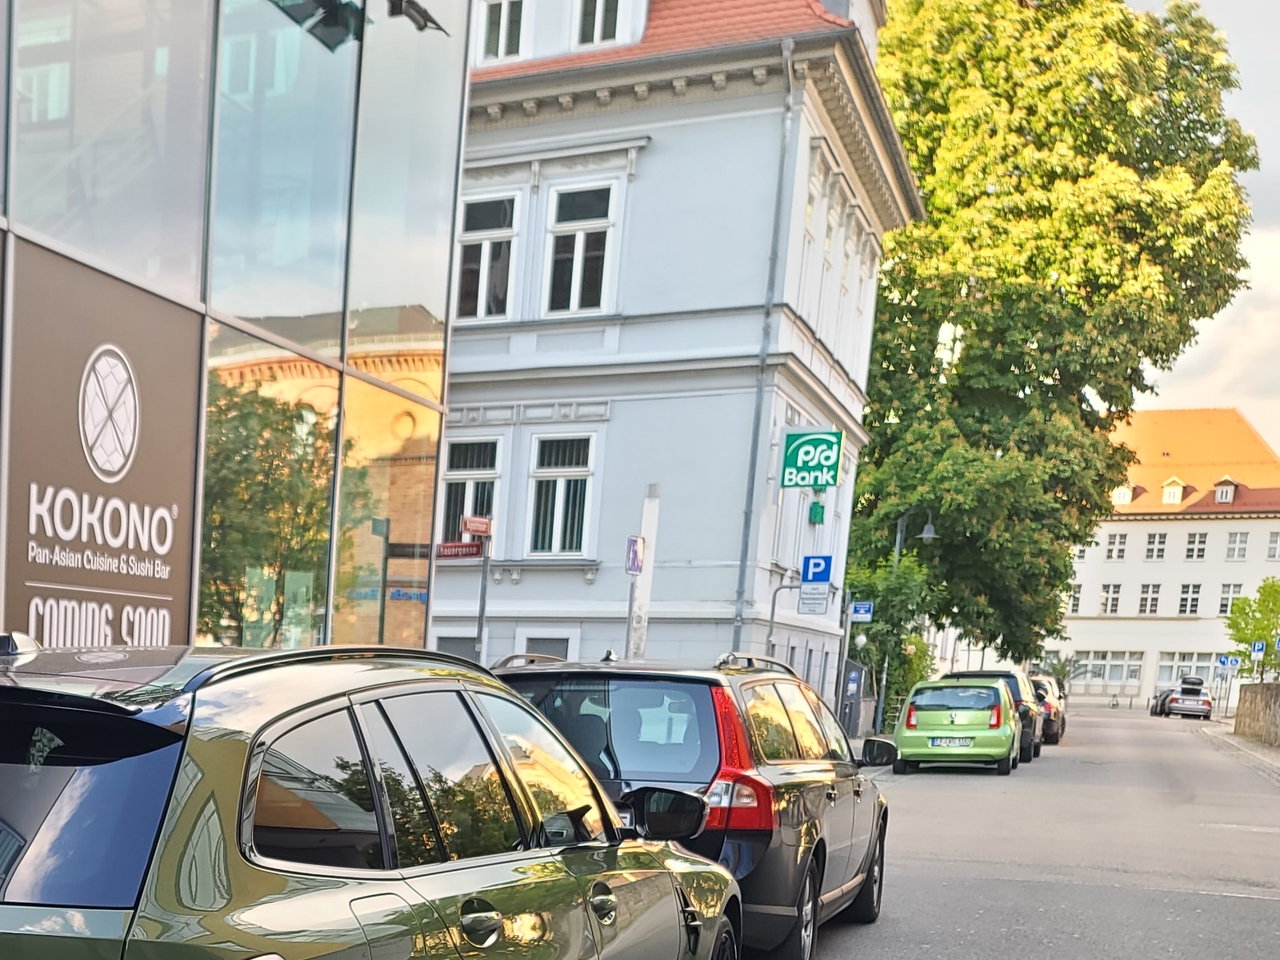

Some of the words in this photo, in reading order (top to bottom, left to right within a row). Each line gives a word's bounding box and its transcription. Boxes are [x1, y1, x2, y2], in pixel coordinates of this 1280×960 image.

[796, 443, 838, 468] psd
[783, 466, 835, 486] Bank
[27, 541, 82, 569] Pan-Asian
[83, 550, 119, 573] Cuisine
[120, 554, 128, 575] &
[128, 556, 153, 577] Sushi
[154, 561, 171, 579] Bar
[807, 558, 826, 581] P
